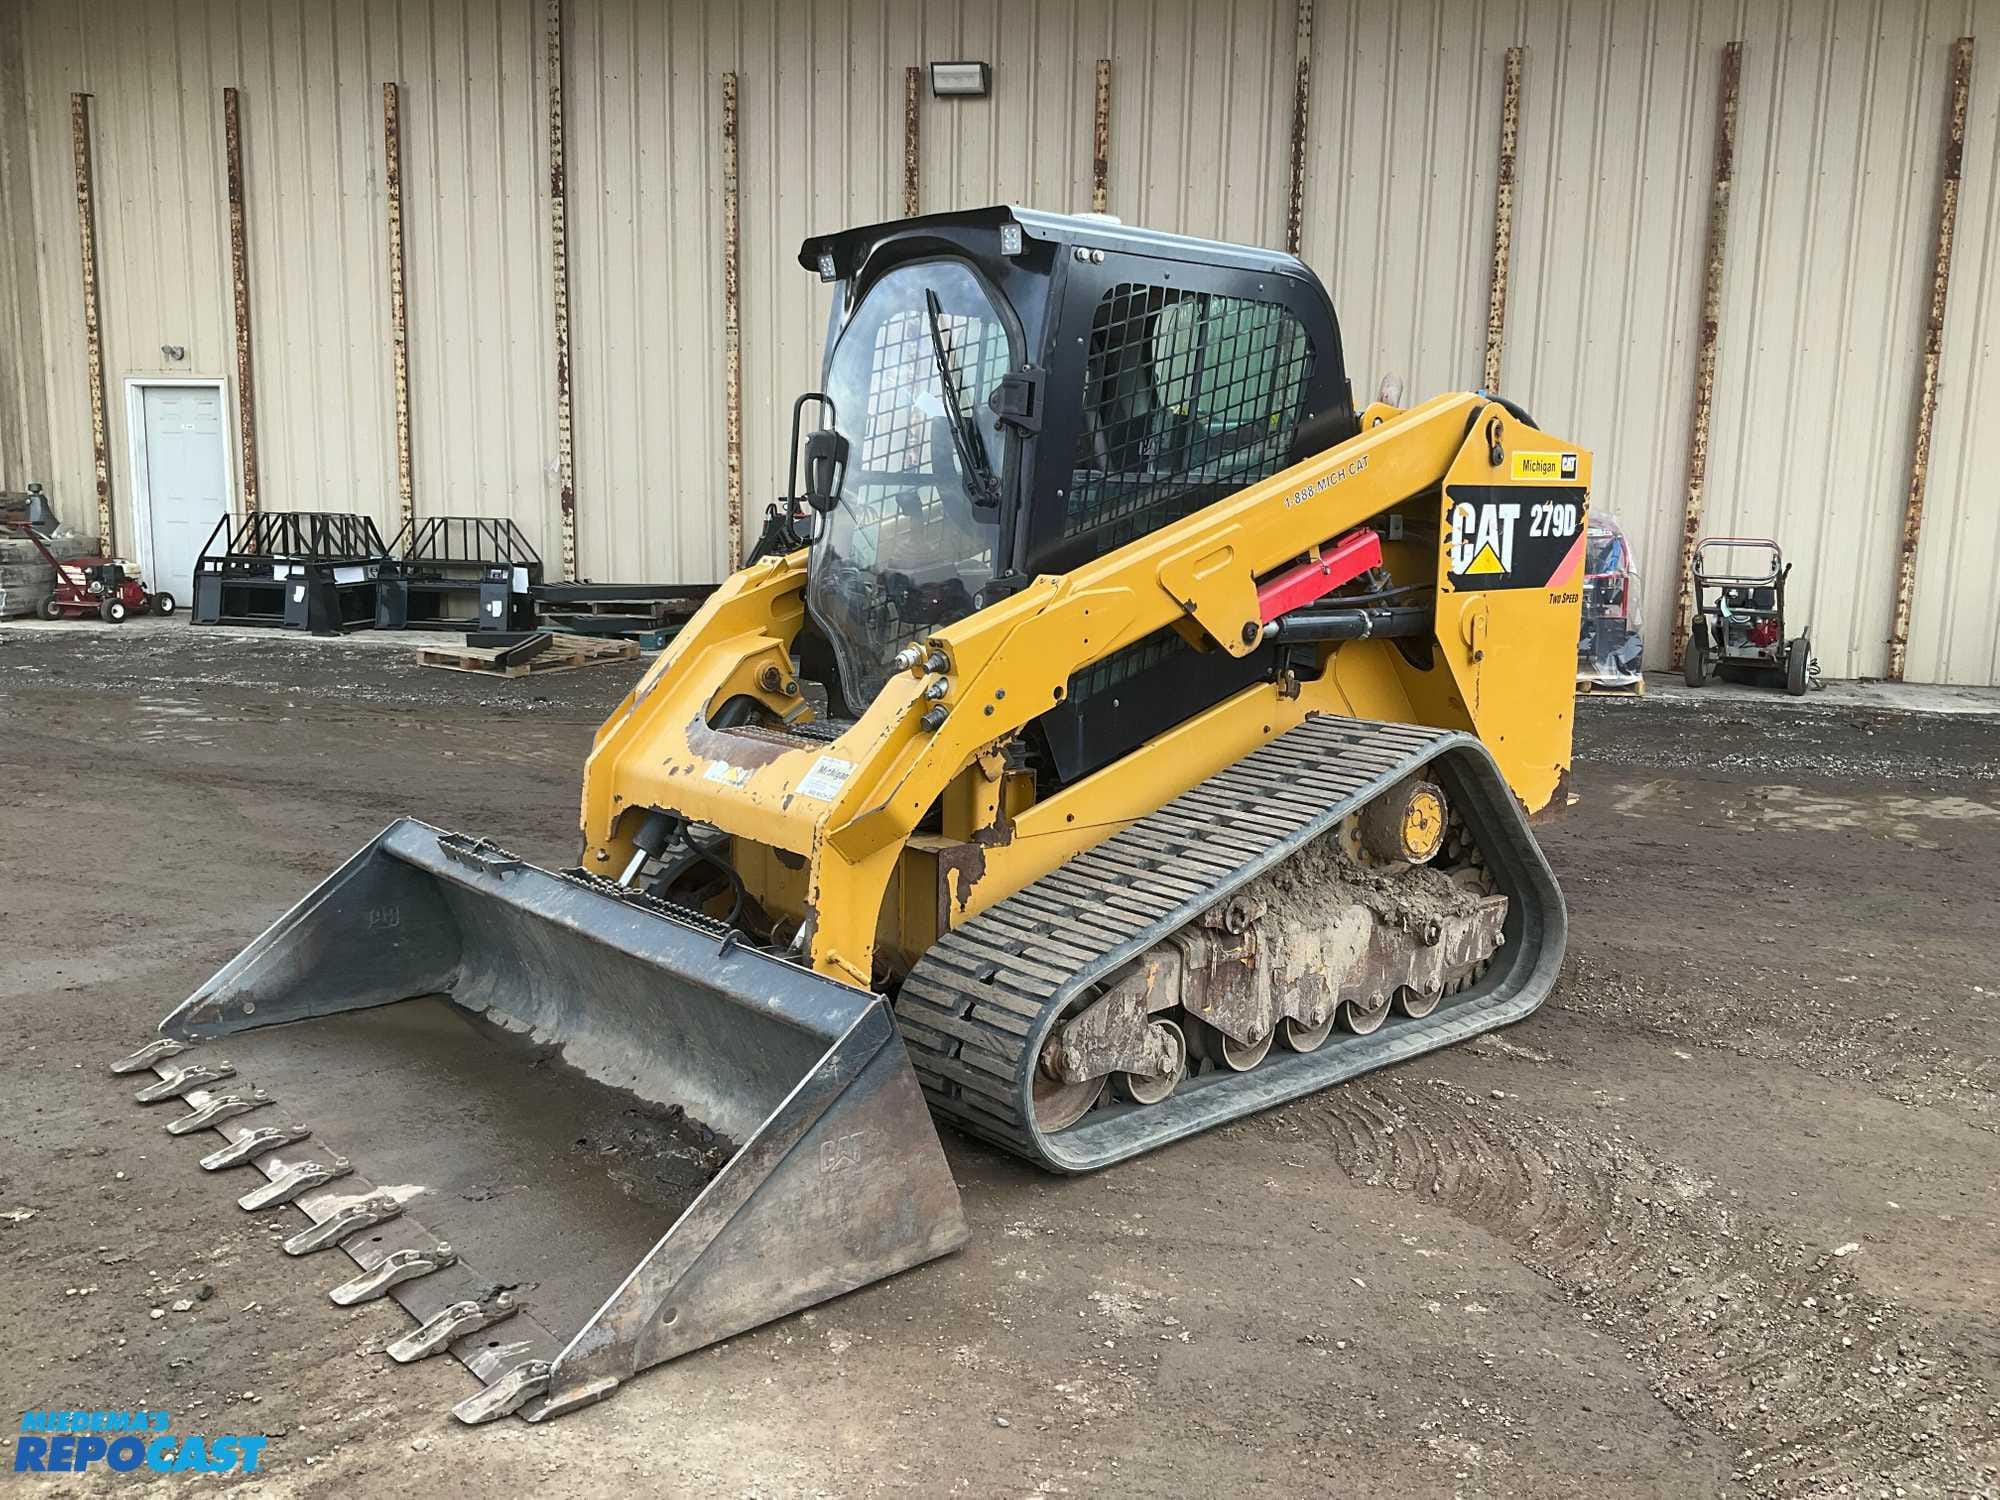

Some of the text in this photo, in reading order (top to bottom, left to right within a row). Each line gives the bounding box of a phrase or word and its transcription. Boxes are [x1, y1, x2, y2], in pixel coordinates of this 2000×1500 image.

[1347, 455, 1370, 477] CAT
[1522, 455, 1577, 475] Michigan CAT
[1530, 502, 1577, 538] 279D
[1452, 502, 1520, 575] CAT
